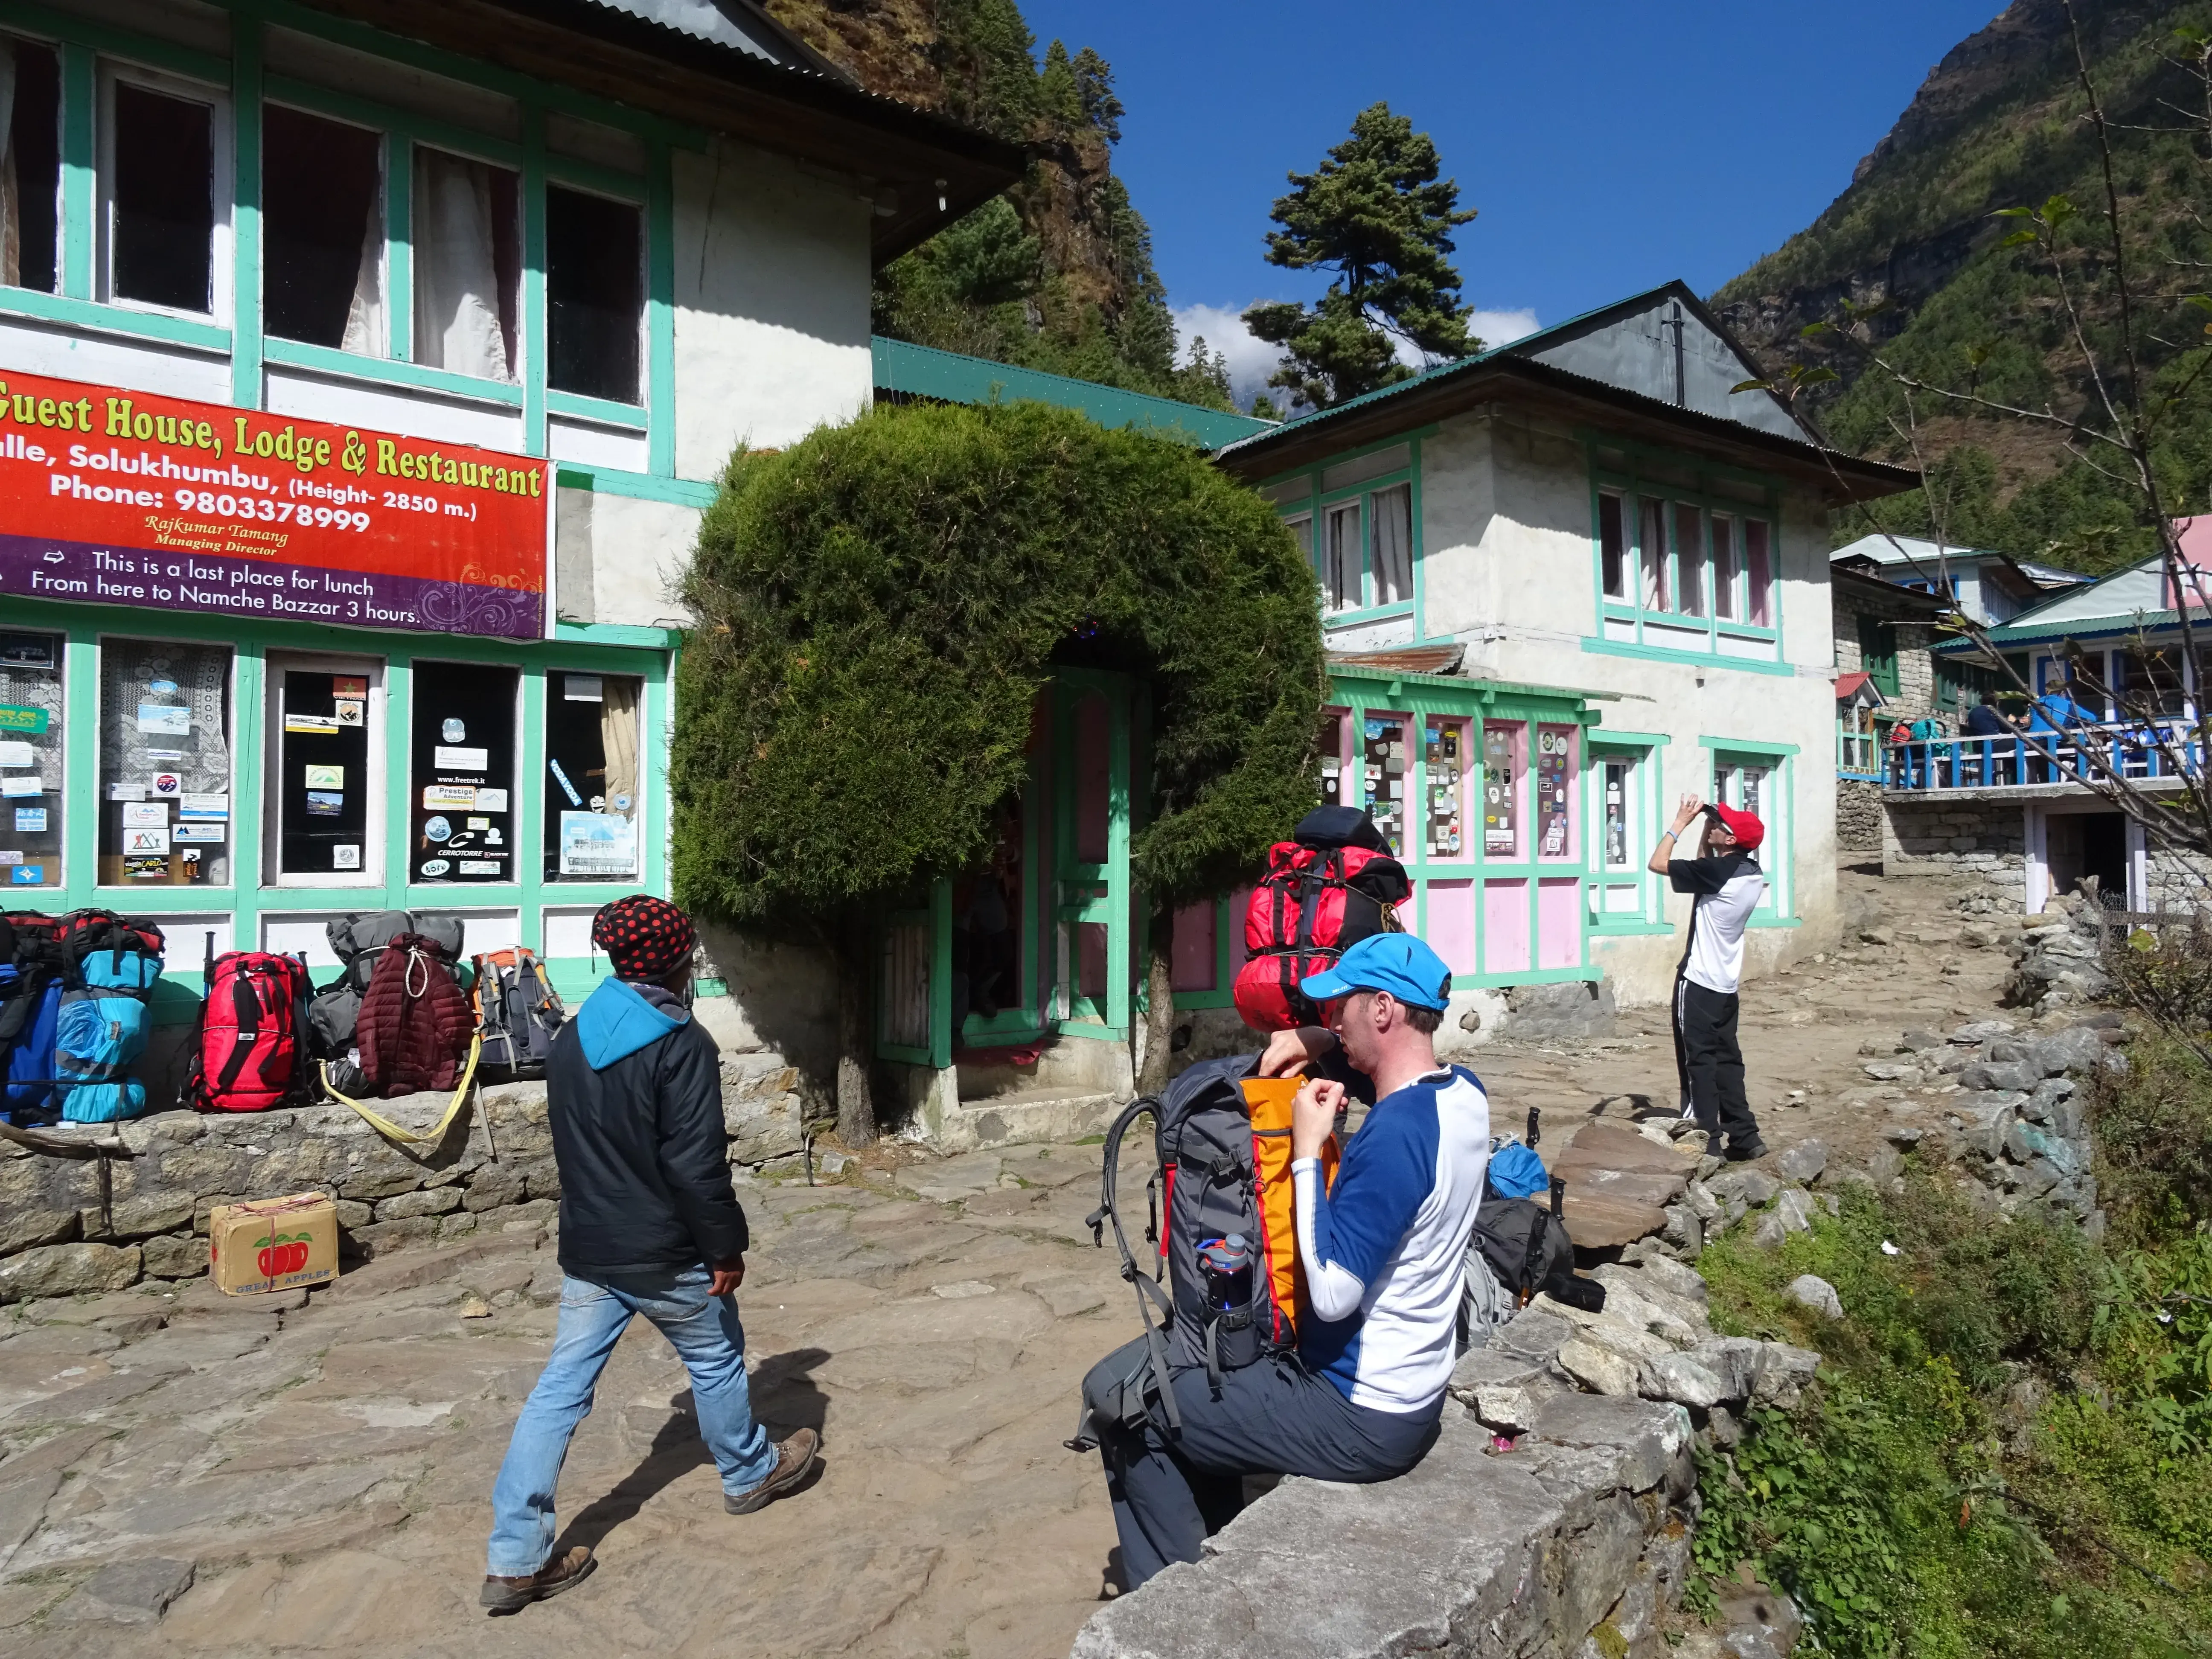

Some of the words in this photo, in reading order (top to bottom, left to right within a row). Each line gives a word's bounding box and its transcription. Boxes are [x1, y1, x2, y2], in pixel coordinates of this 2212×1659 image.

[105, 398, 222, 459] House,
[234, 417, 331, 472] Lodge
[341, 431, 366, 477] &
[377, 439, 541, 498] Restaurant
[51, 474, 163, 508] Phone:
[175, 490, 370, 532] 9803378999
[69, 445, 279, 495] Solukhumbu,
[289, 480, 376, 505] (Height-
[384, 492, 437, 513] 2850
[445, 502, 476, 521] m.)
[145, 515, 224, 535] Rajkumar
[228, 525, 288, 547] Tamang
[155, 534, 221, 552] Managing
[225, 541, 277, 556] Director
[32, 571, 87, 593] From
[97, 574, 144, 598] here
[152, 584, 172, 601] to
[180, 585, 265, 609] Namche
[272, 597, 340, 616] Bazzar
[347, 601, 358, 617] 3
[366, 603, 420, 623] hours.
[92, 551, 134, 572] This
[144, 558, 159, 575] is
[167, 565, 180, 577] a
[189, 559, 224, 582] last
[230, 565, 285, 587] place
[292, 570, 318, 590] for
[326, 573, 373, 596] lunch
[236, 1278, 276, 1293] GREAT
[285, 1269, 330, 1284] APPLES
